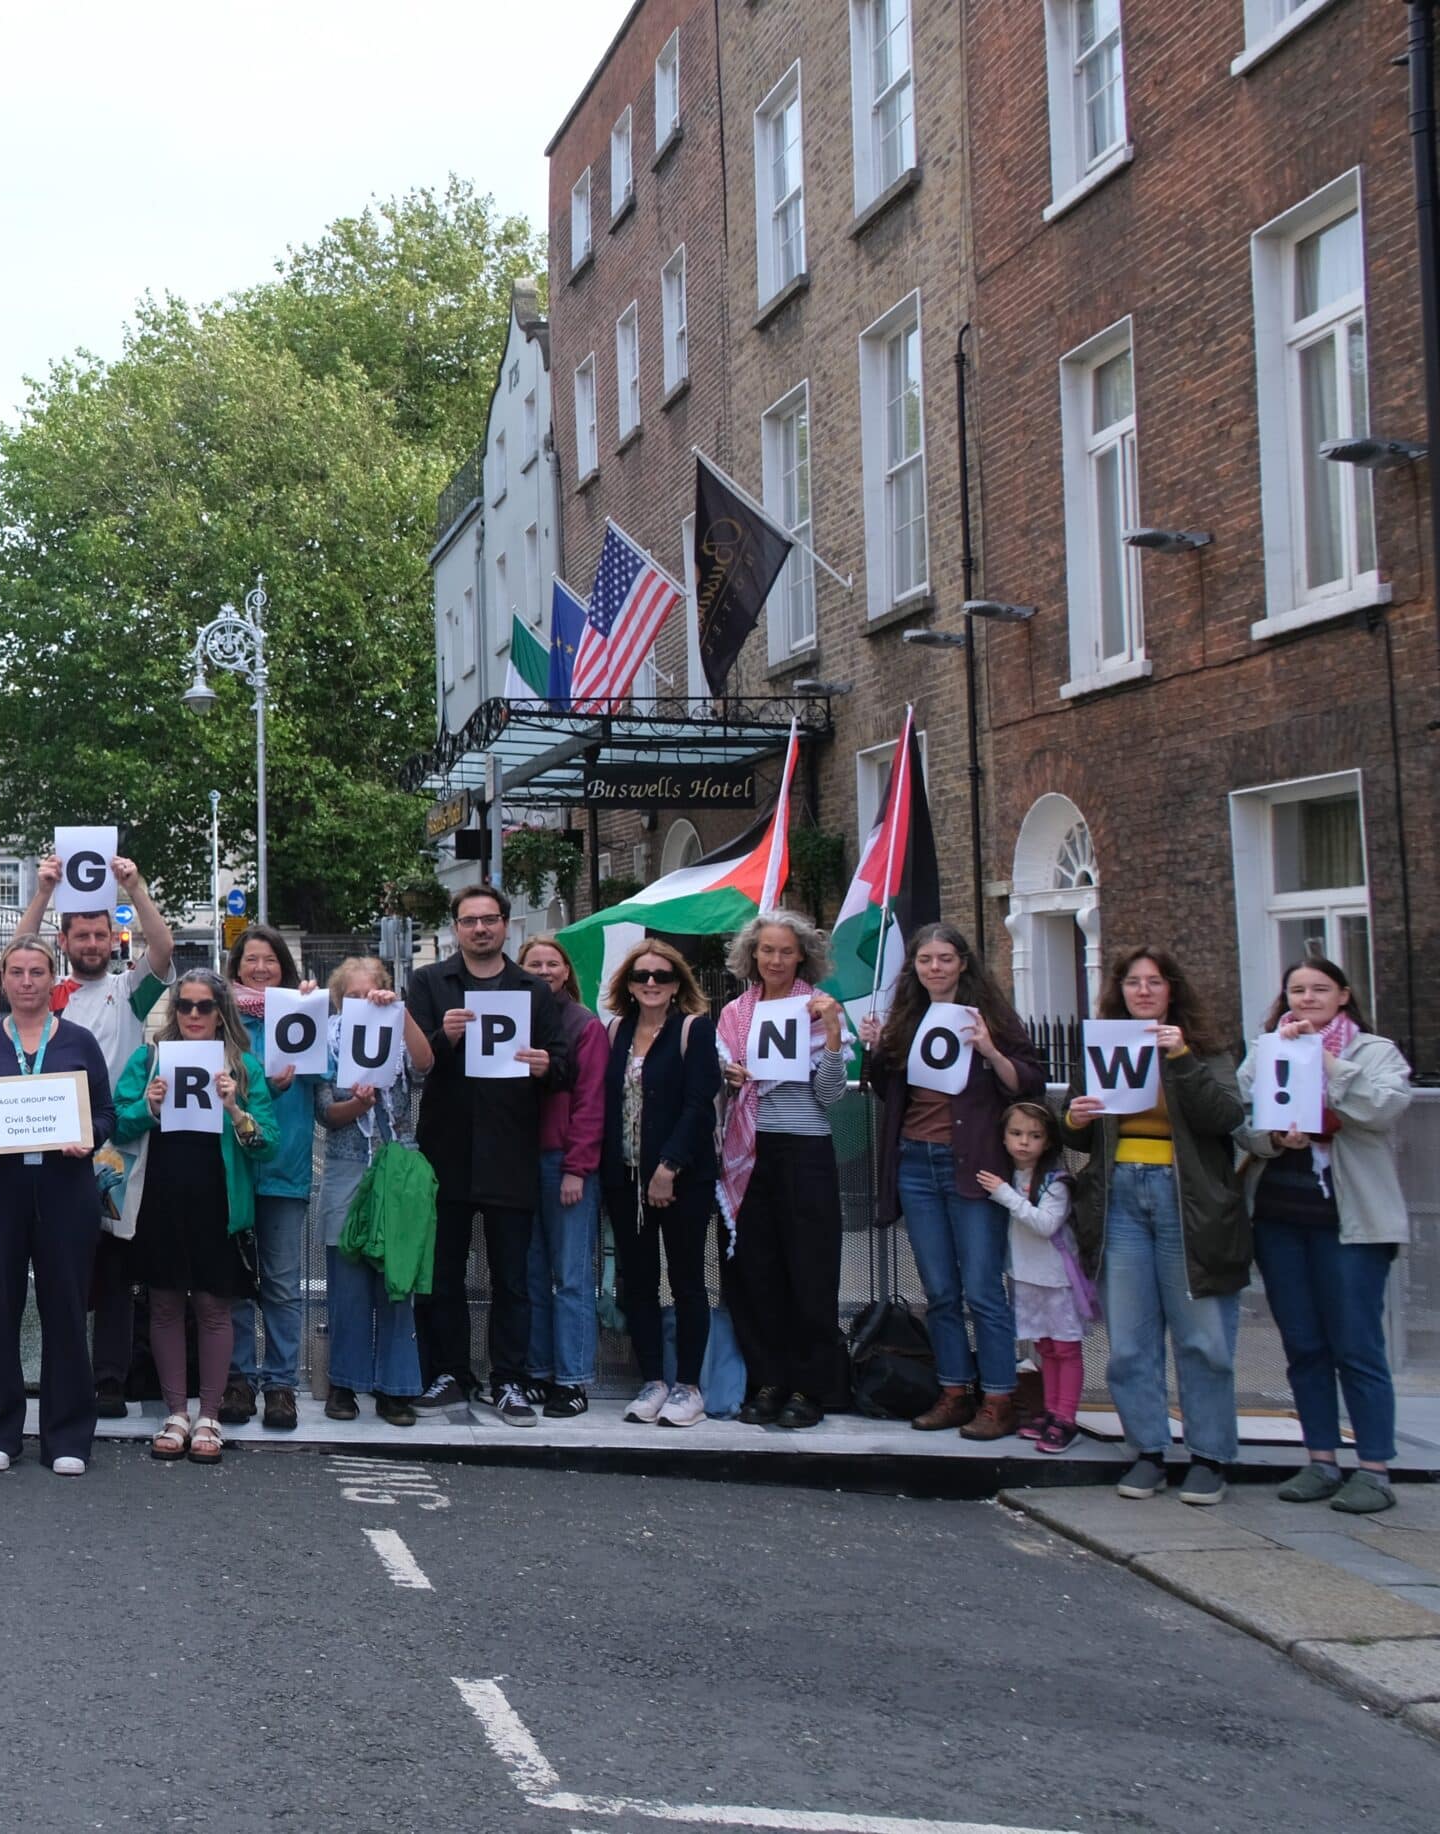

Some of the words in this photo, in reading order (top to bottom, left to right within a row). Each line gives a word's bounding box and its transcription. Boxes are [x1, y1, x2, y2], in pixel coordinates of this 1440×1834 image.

[587, 776, 681, 799] Buswells
[688, 776, 753, 799] Hotel
[66, 851, 107, 893] G
[275, 1013, 316, 1054] O
[351, 1025, 393, 1069] U
[481, 1015, 517, 1057] P
[758, 1019, 797, 1060] N
[920, 1027, 961, 1070] O
[174, 1066, 213, 1110] R
[1087, 1046, 1155, 1090] W
[1274, 1060, 1291, 1105] !
[5, 1114, 24, 1124] Civil
[26, 1114, 57, 1123] Society
[20, 1096, 46, 1104] GROUP
[7, 1127, 30, 1136] Open
[32, 1126, 56, 1134] Letter
